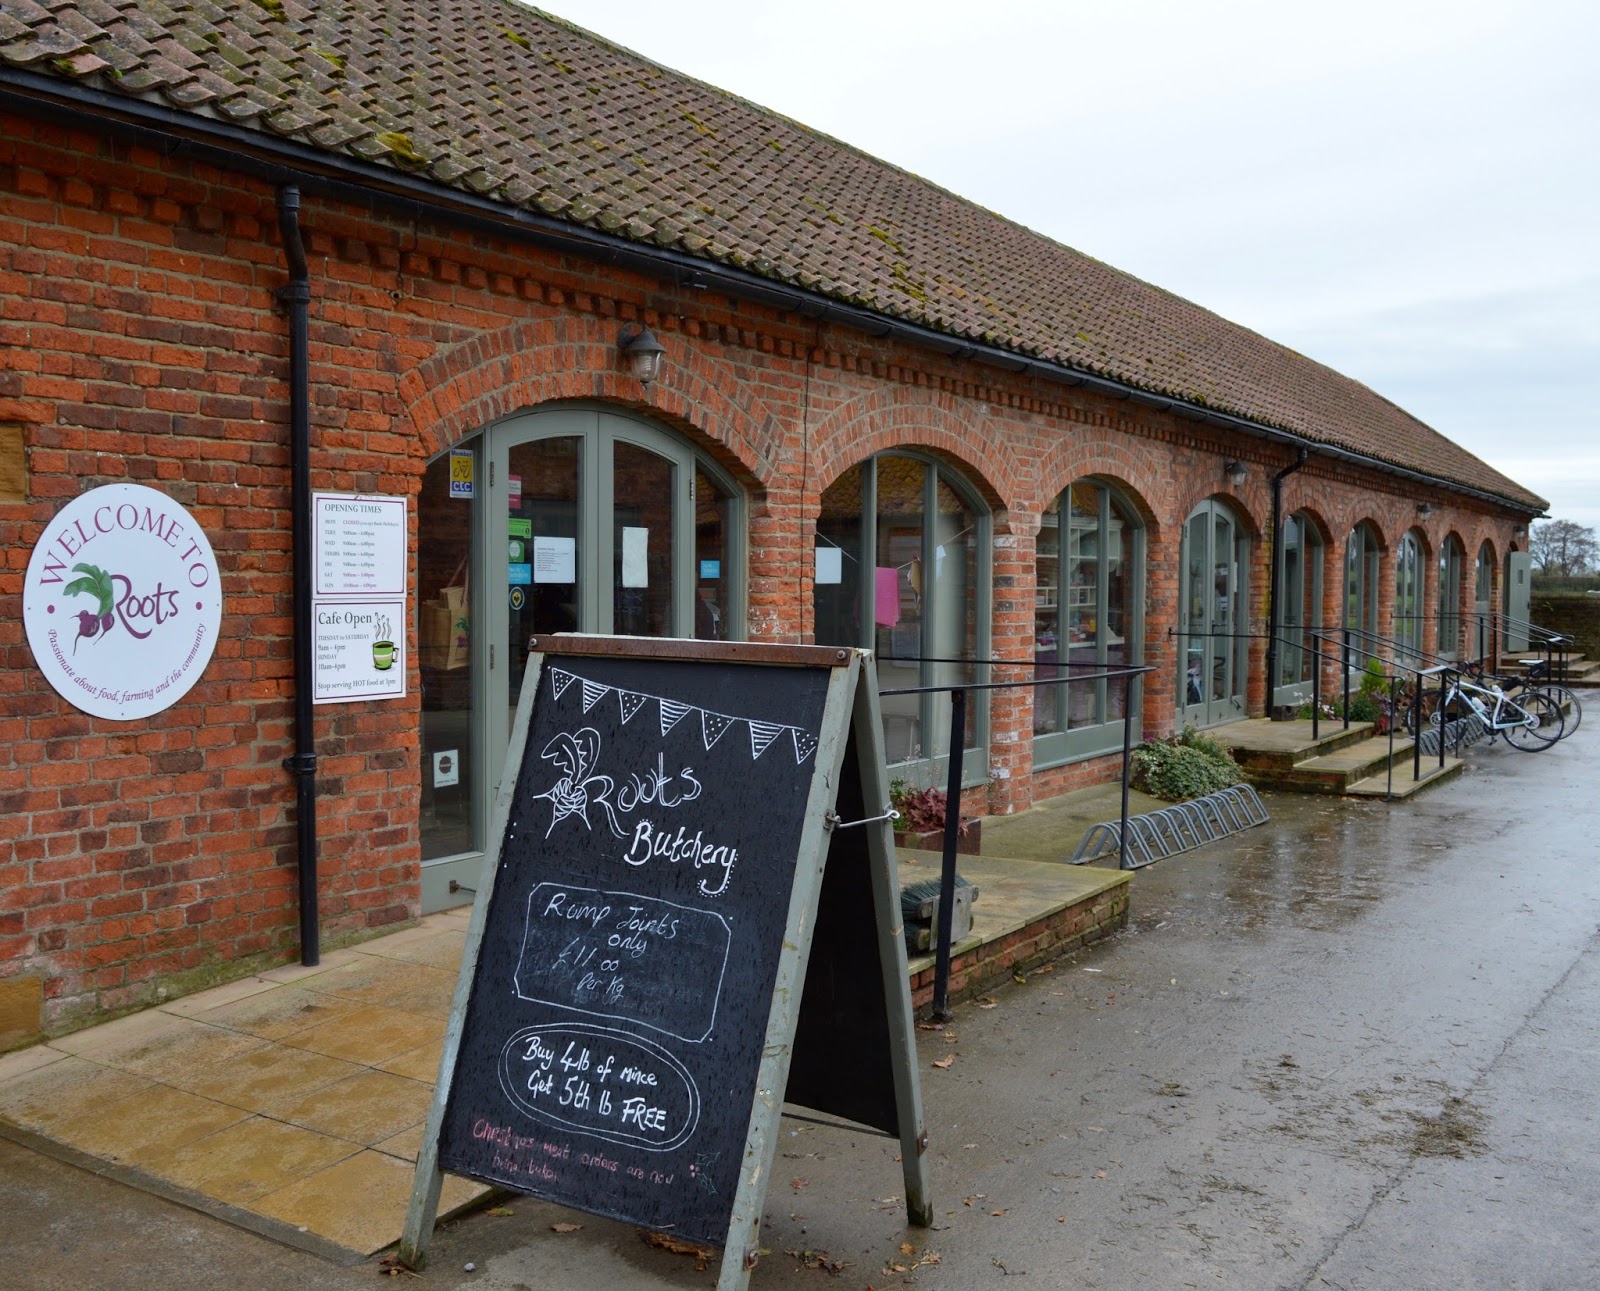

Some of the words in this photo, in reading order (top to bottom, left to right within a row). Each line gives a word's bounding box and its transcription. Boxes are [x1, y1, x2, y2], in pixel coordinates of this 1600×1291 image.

[324, 504, 358, 512] OPENING
[360, 505, 382, 513] TIMES
[453, 481, 470, 492] ctc
[40, 504, 184, 586] WELCOME
[180, 537, 208, 588] TO
[110, 574, 180, 639] Roots
[318, 612, 342, 624] Cafe
[344, 612, 372, 628] Open
[48, 629, 75, 678] Passionate
[74, 675, 98, 694] about
[96, 688, 118, 702] food,
[119, 690, 154, 704] farming
[156, 679, 170, 694] and
[171, 669, 182, 682] the
[182, 623, 206, 672] community
[318, 682, 330, 691] Stop
[332, 681, 352, 690] serving
[583, 752, 702, 839] Roots
[623, 820, 737, 895] Butchery
[544, 892, 611, 927] Rump
[616, 906, 680, 939] Joints
[522, 1036, 555, 1070] Buy
[560, 1041, 590, 1072] 4lb
[597, 1056, 614, 1082] of
[528, 1070, 554, 1098] Get
[559, 1076, 590, 1110] 5th
[600, 1090, 612, 1116] lb
[622, 1096, 667, 1131] FREE
[473, 1119, 534, 1150] Chrstas
[626, 1166, 644, 1179] are
